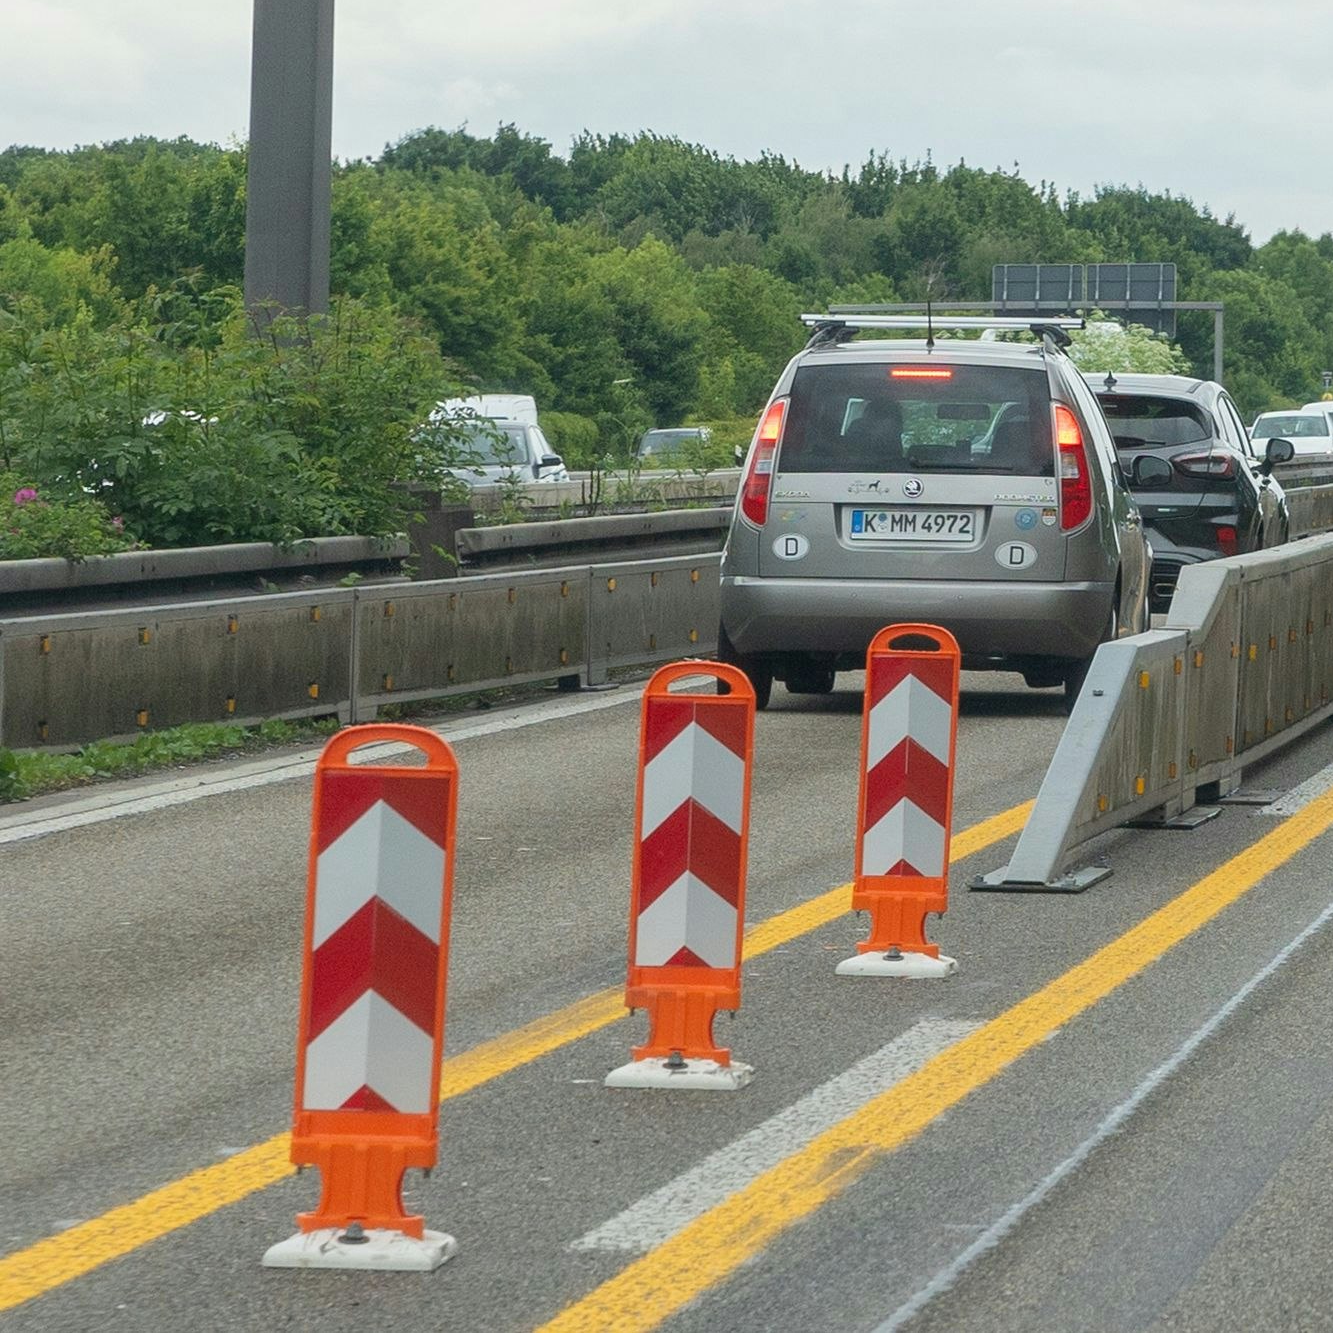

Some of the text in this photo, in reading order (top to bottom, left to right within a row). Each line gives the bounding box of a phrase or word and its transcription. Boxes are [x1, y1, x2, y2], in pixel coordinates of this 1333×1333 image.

[863, 513, 971, 535] K MM 4972
[785, 538, 798, 557] D
[1009, 545, 1024, 565] D
